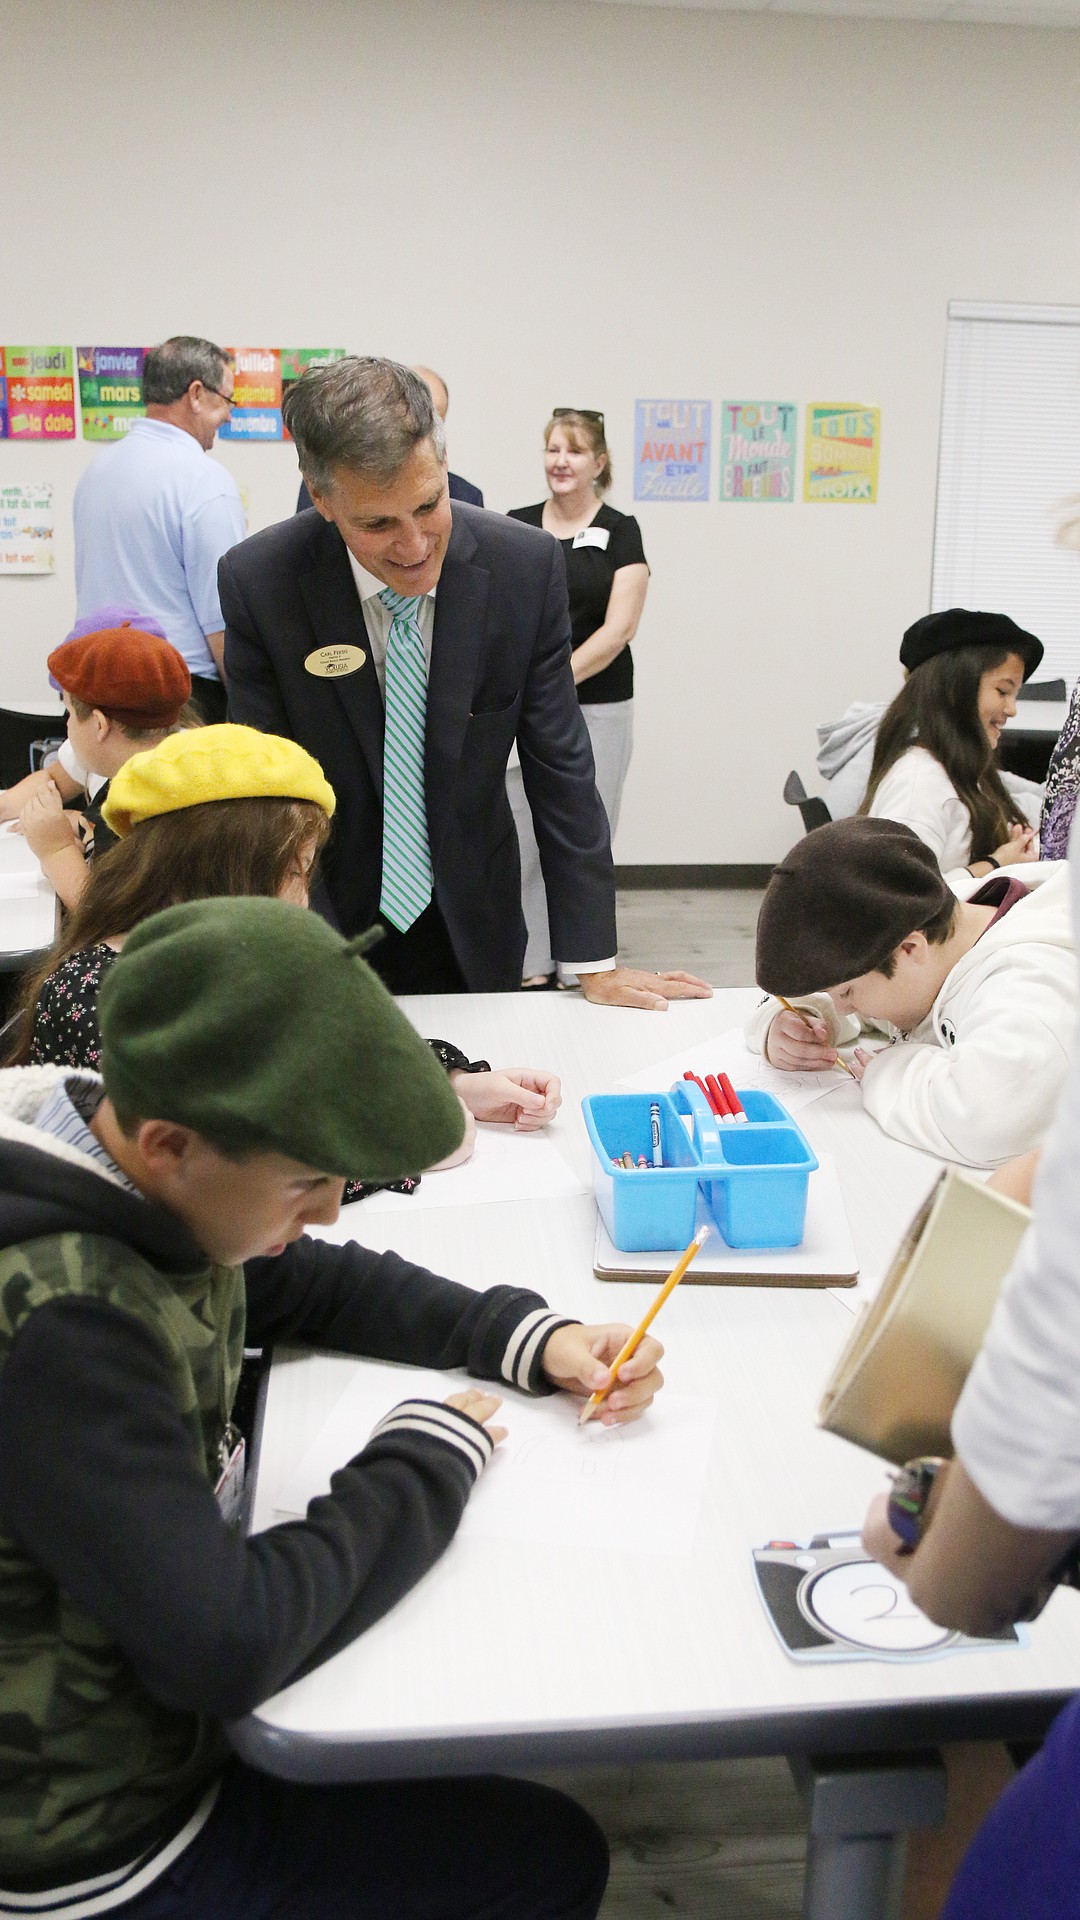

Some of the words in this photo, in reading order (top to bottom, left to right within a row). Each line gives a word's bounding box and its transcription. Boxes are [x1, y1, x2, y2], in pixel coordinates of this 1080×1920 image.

[30, 351, 66, 374] jeudi
[94, 351, 139, 375] janvier
[235, 352, 275, 376] juillet
[26, 383, 73, 402] samedi
[99, 385, 141, 402] mars
[28, 413, 42, 432] la
[44, 413, 73, 432] date
[230, 413, 277, 433] novembre
[641, 403, 708, 428] TOUT
[726, 404, 793, 432] TOUT
[752, 426, 765, 441] LE
[640, 441, 705, 464] AVANT
[727, 429, 790, 462] Monde
[849, 1583, 919, 1622] 2
